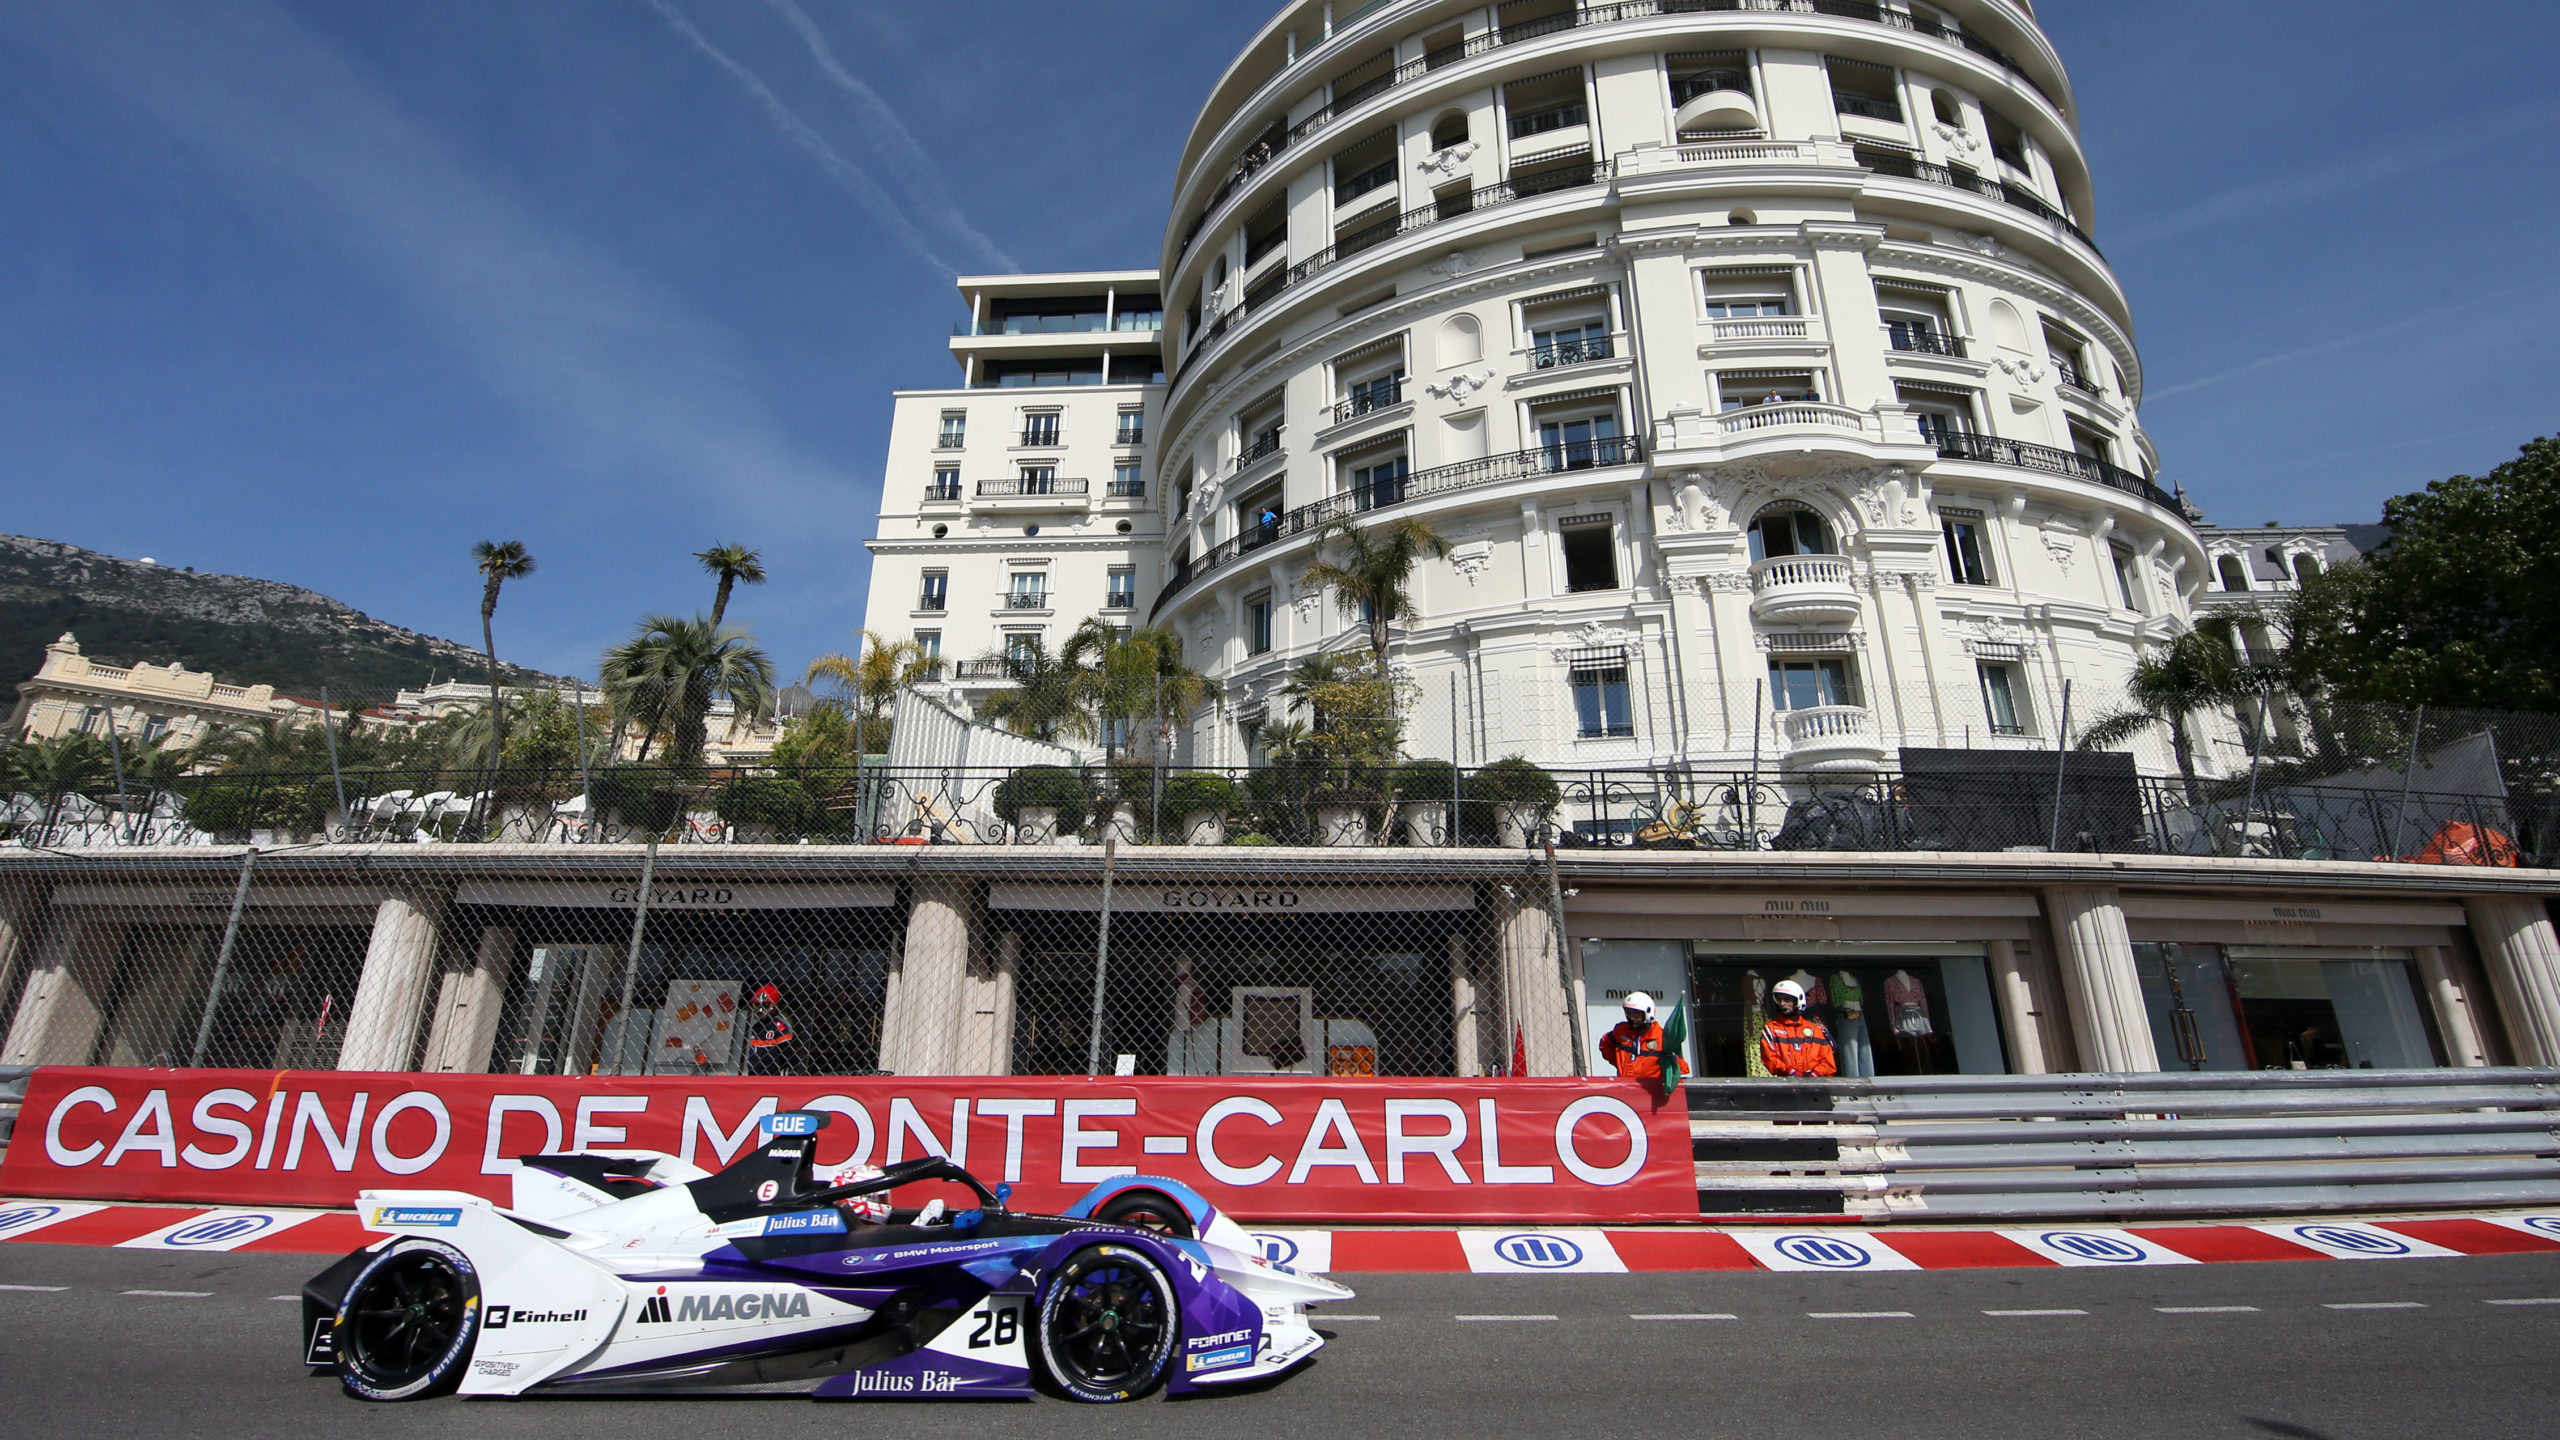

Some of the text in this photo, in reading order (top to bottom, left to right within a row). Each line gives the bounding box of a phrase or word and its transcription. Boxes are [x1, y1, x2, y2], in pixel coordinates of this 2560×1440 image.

[1163, 890, 1299, 907] GOYARD
[771, 1116, 806, 1133] GUE
[44, 1086, 1649, 1187] CASINO DE MONTE-CARLO
[768, 1148, 802, 1158] MAGNA
[397, 1213, 454, 1222] MICHELIN
[768, 1213, 838, 1233] Julius Bär
[893, 1241, 1000, 1259] BMW Motorsport
[512, 1309, 587, 1323] Einhell
[677, 1293, 811, 1322] MAGNA
[968, 1307, 1018, 1350] 28
[432, 1319, 471, 1377] MICHELIN
[1206, 1351, 1246, 1365] MICHELIN
[852, 1369, 961, 1396] Julius Bär
[1069, 1386, 1112, 1401] MICHELIN
